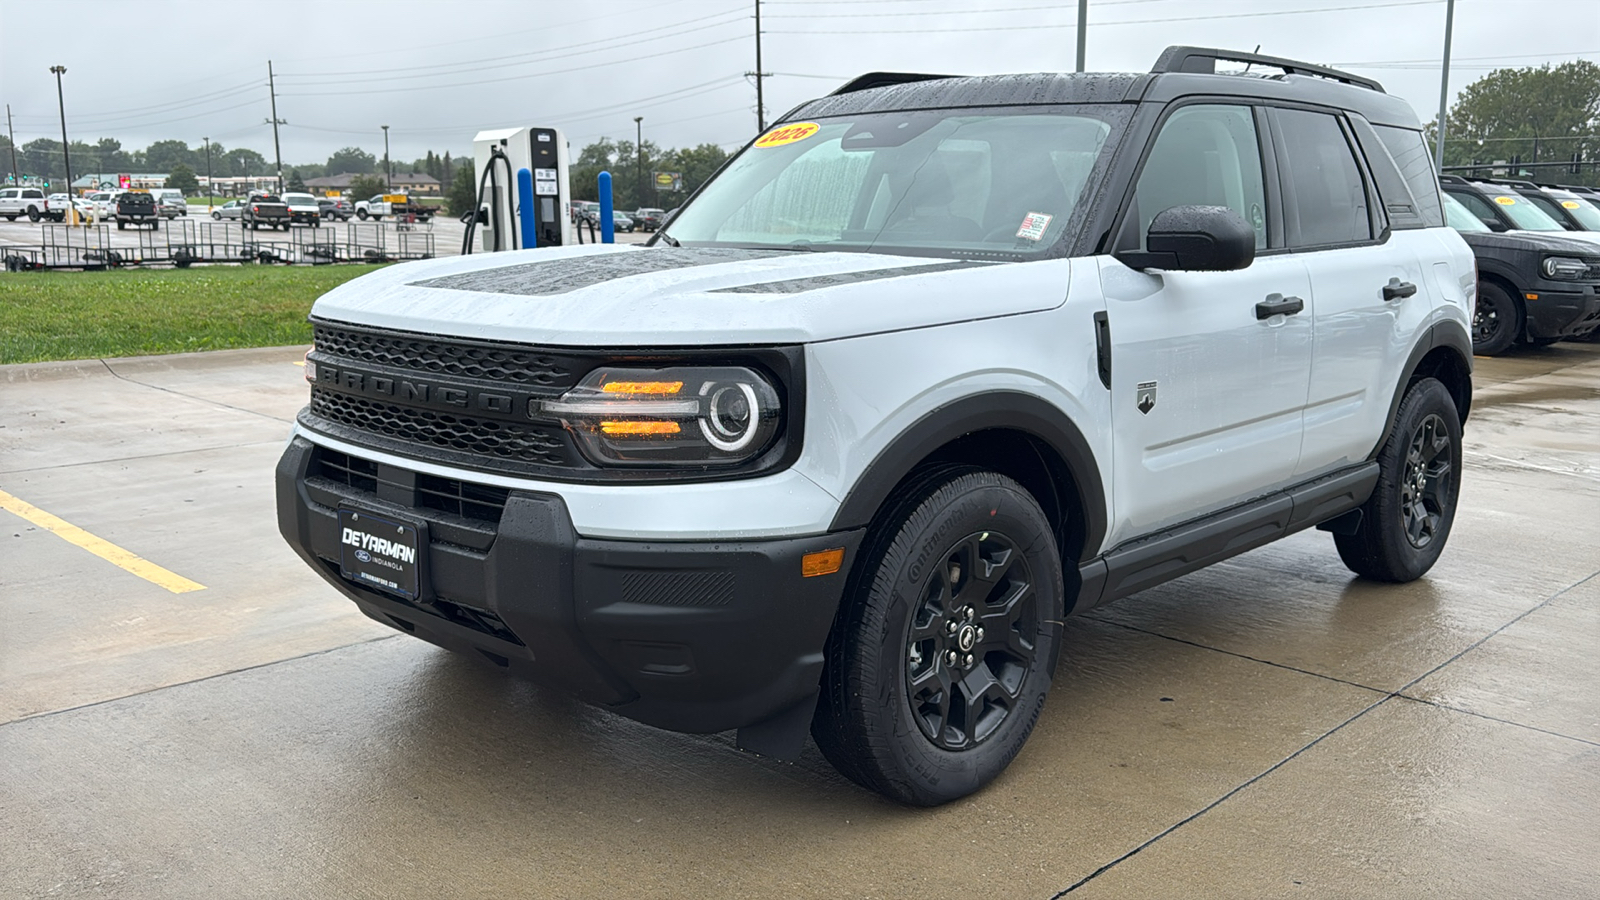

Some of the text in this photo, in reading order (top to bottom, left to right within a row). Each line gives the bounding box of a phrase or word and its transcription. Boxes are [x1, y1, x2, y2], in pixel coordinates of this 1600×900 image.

[758, 126, 814, 144] 2026
[320, 366, 512, 413] BRONCO
[342, 527, 415, 564] DEYARMAN
[371, 556, 404, 572] INDIANOLA
